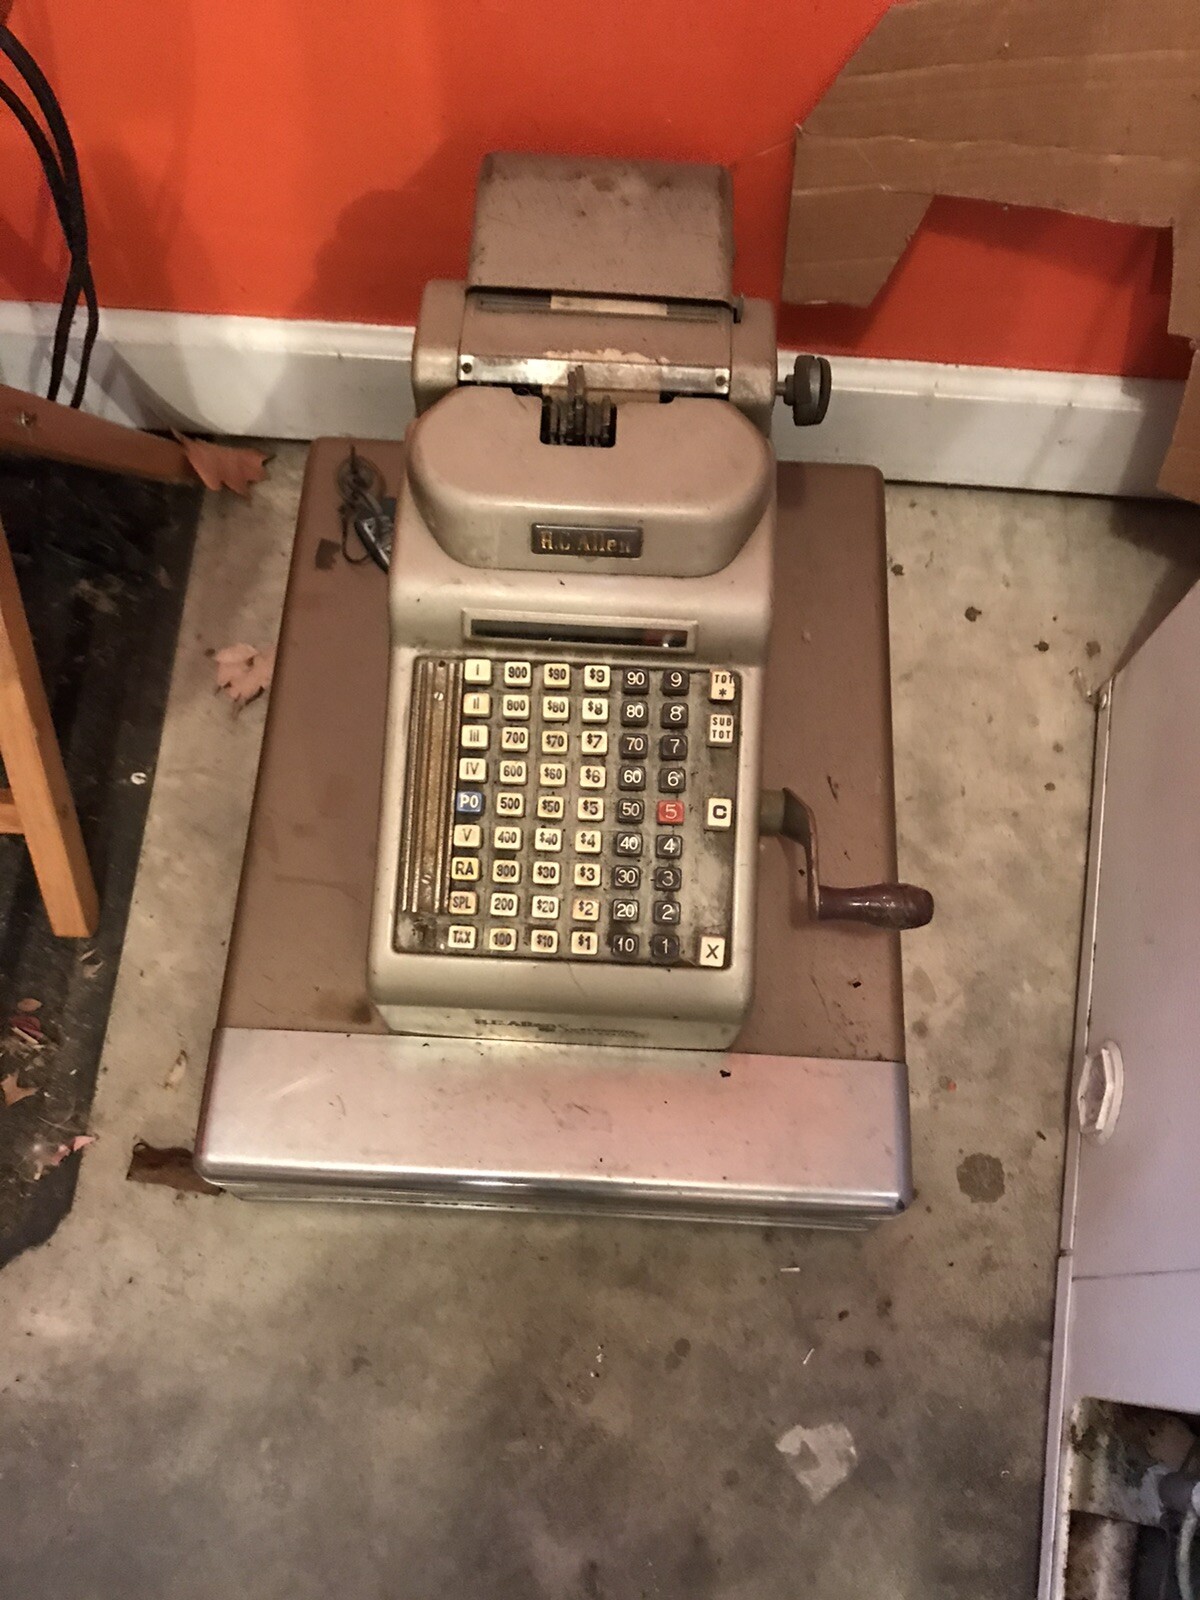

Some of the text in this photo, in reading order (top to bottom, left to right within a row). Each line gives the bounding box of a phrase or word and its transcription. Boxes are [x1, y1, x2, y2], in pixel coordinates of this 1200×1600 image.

[508, 666, 528, 679] 900
[548, 667, 567, 680] $90
[589, 667, 605, 683] $9
[627, 671, 645, 686] 90
[670, 672, 683, 687] 9
[588, 700, 603, 716] $8
[626, 704, 644, 718] 80
[669, 706, 682, 721] 8
[712, 716, 732, 727] SUB
[505, 731, 526, 744] 700
[546, 734, 565, 748] $70
[587, 733, 603, 748] $7
[712, 729, 731, 739] TOT
[626, 737, 644, 751] 70
[669, 738, 681, 754] 7
[465, 761, 480, 775] IV
[503, 765, 523, 777] 600
[544, 767, 563, 780] $60
[585, 767, 601, 783] $6
[623, 769, 642, 783] 60
[667, 771, 680, 787] 6
[500, 796, 520, 810] 500
[541, 799, 560, 813] $50
[582, 799, 599, 816] $5
[622, 802, 640, 817] 50
[665, 803, 678, 820] 5
[712, 804, 728, 820] C
[462, 828, 473, 842] V
[497, 831, 517, 844] 400
[580, 832, 596, 848] $4
[620, 836, 639, 850] 40
[663, 838, 675, 853] 4
[455, 861, 474, 876] RA
[496, 864, 516, 878] 300
[537, 865, 556, 879] $30
[580, 865, 595, 882] $3
[617, 869, 636, 884] 30
[661, 870, 674, 886] 3
[452, 896, 472, 909] SPL
[494, 897, 514, 911] 200
[537, 899, 555, 913] $20
[578, 900, 594, 916] $2
[616, 903, 635, 918] 20
[661, 904, 673, 920] 2
[452, 930, 471, 943] TAX
[493, 932, 512, 946] 100
[578, 933, 591, 951] $1
[617, 936, 635, 952] 10
[662, 938, 669, 954] 1
[705, 943, 720, 959] X
